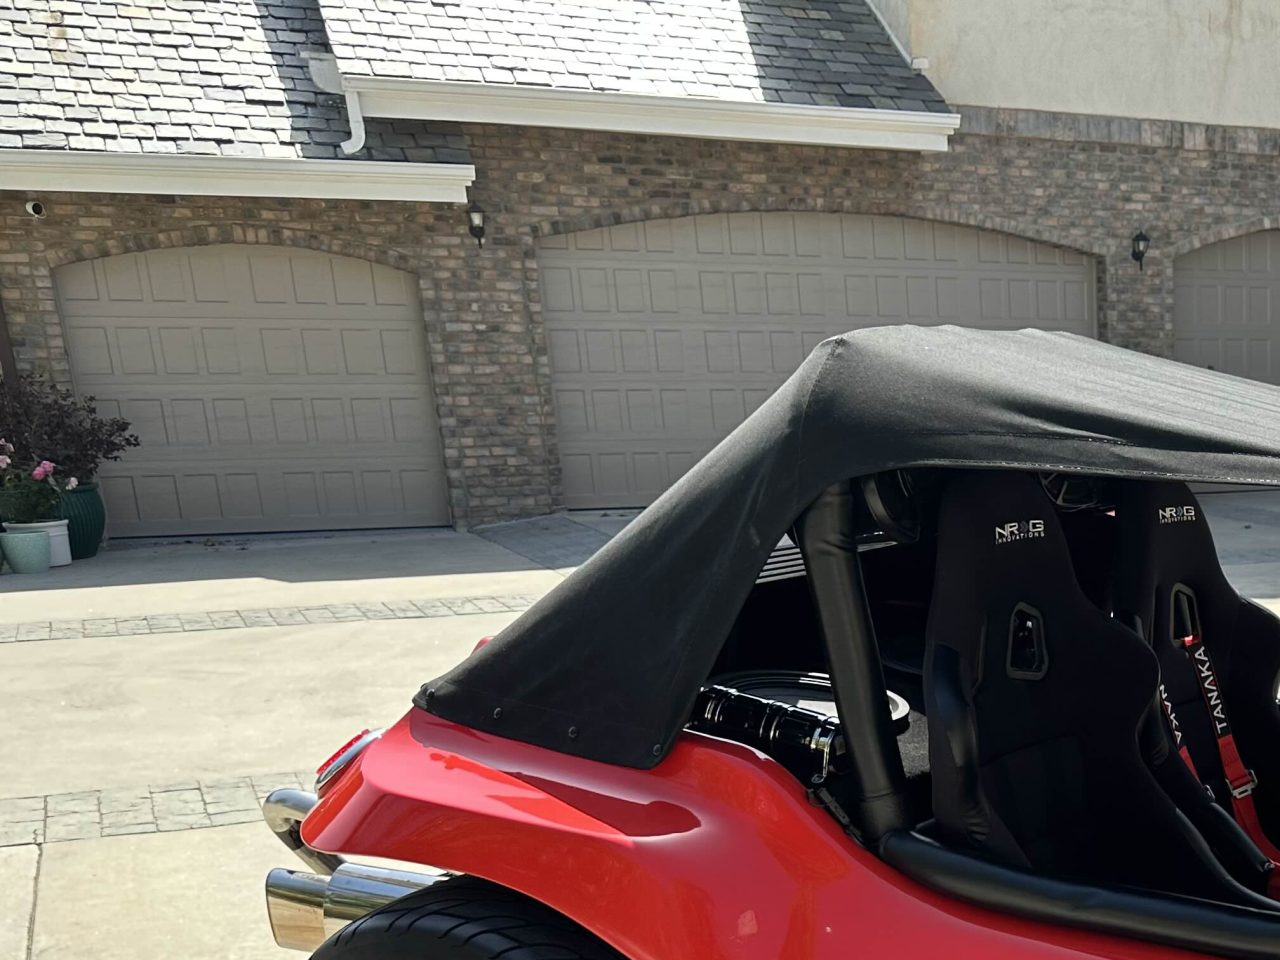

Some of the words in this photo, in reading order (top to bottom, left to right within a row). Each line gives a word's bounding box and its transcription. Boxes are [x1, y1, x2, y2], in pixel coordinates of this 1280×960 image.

[995, 531, 1045, 545] INNOVATIONS
[1159, 683, 1183, 745] NAKA
[1194, 645, 1228, 734] TANAKA
